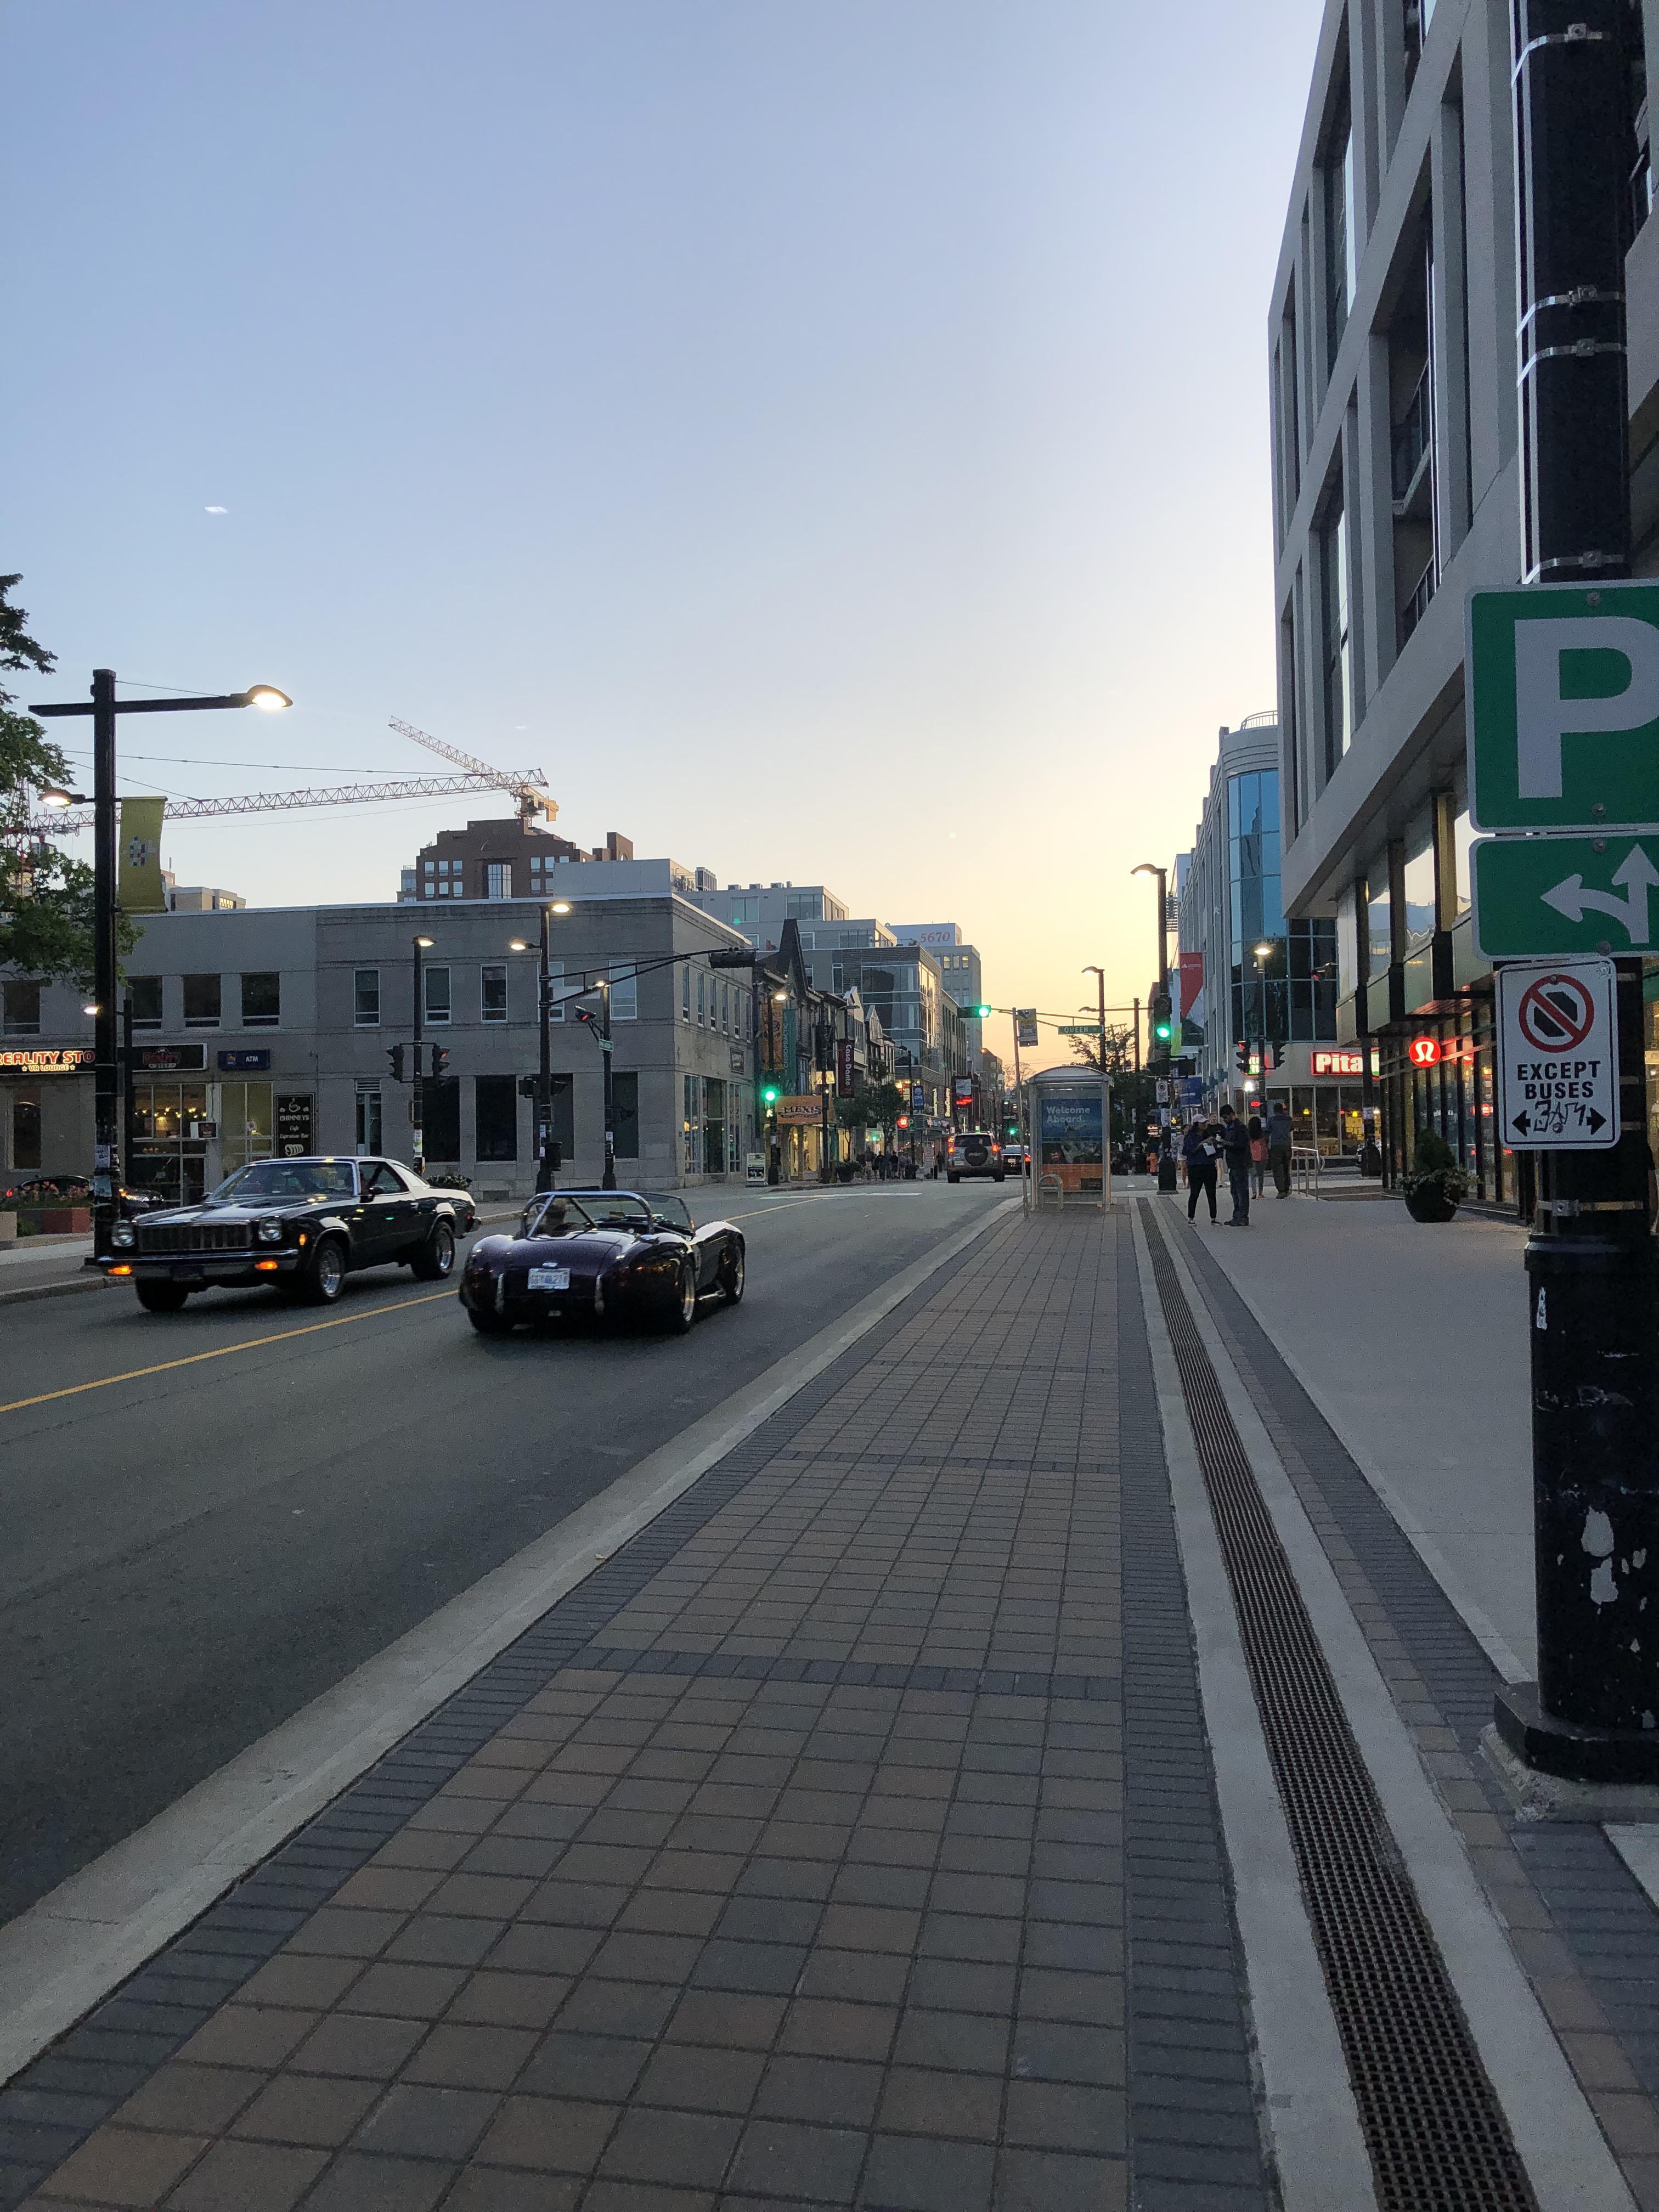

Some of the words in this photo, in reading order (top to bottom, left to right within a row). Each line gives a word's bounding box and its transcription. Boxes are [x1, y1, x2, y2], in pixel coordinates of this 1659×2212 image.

[1515, 616, 1659, 798] P
[920, 932, 950, 943] 5670
[63, 1050, 95, 1063] STO
[1316, 1054, 1363, 1072] Pita
[1517, 1061, 1601, 1081] EXCEPT
[1525, 1082, 1594, 1100] BUSES
[1046, 1106, 1091, 1114] Welcome
